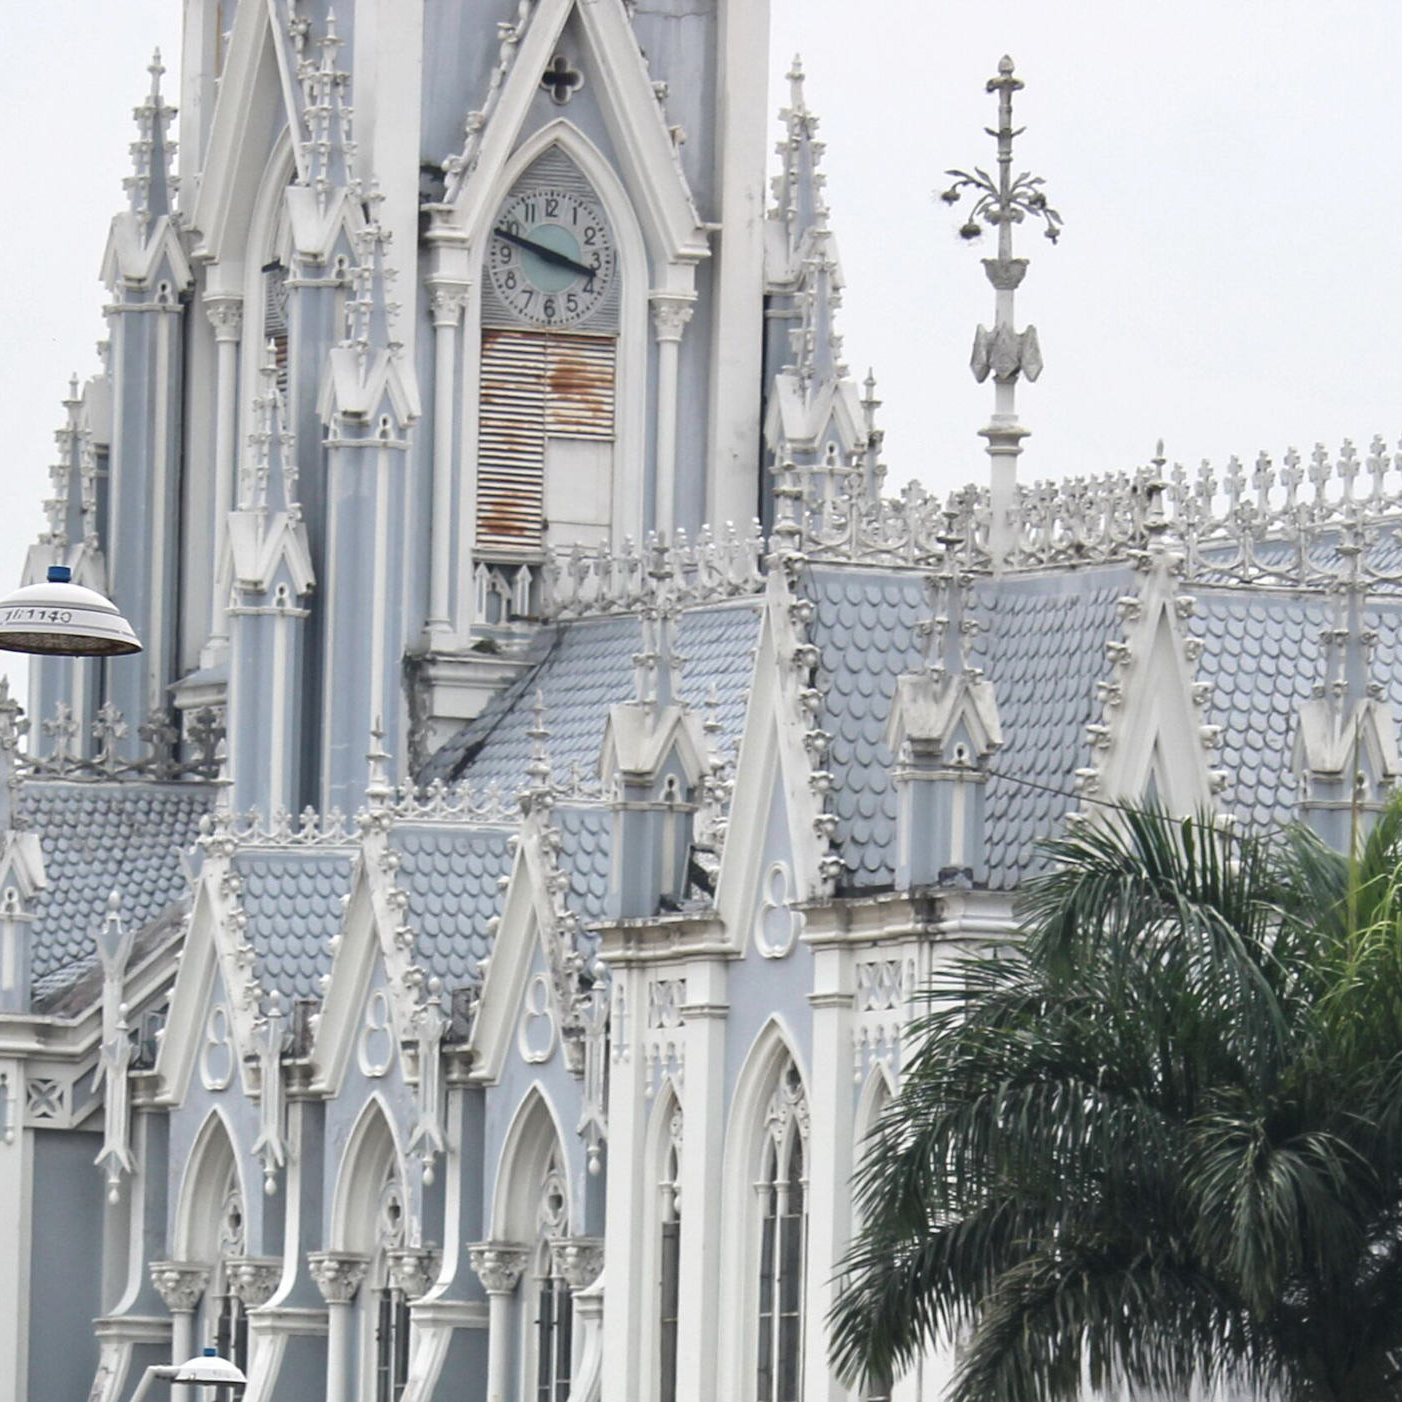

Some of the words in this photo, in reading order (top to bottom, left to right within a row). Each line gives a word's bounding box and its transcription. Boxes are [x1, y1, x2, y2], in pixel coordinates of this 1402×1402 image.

[524, 203, 535, 222] 11
[545, 199, 559, 218] 12
[584, 226, 596, 245] 2
[500, 245, 512, 264] 9
[590, 252, 602, 271] 3
[505, 271, 517, 290] 8
[582, 275, 595, 295] 4
[521, 290, 534, 309] 7
[544, 299, 556, 318] 6
[566, 293, 578, 312] 5
